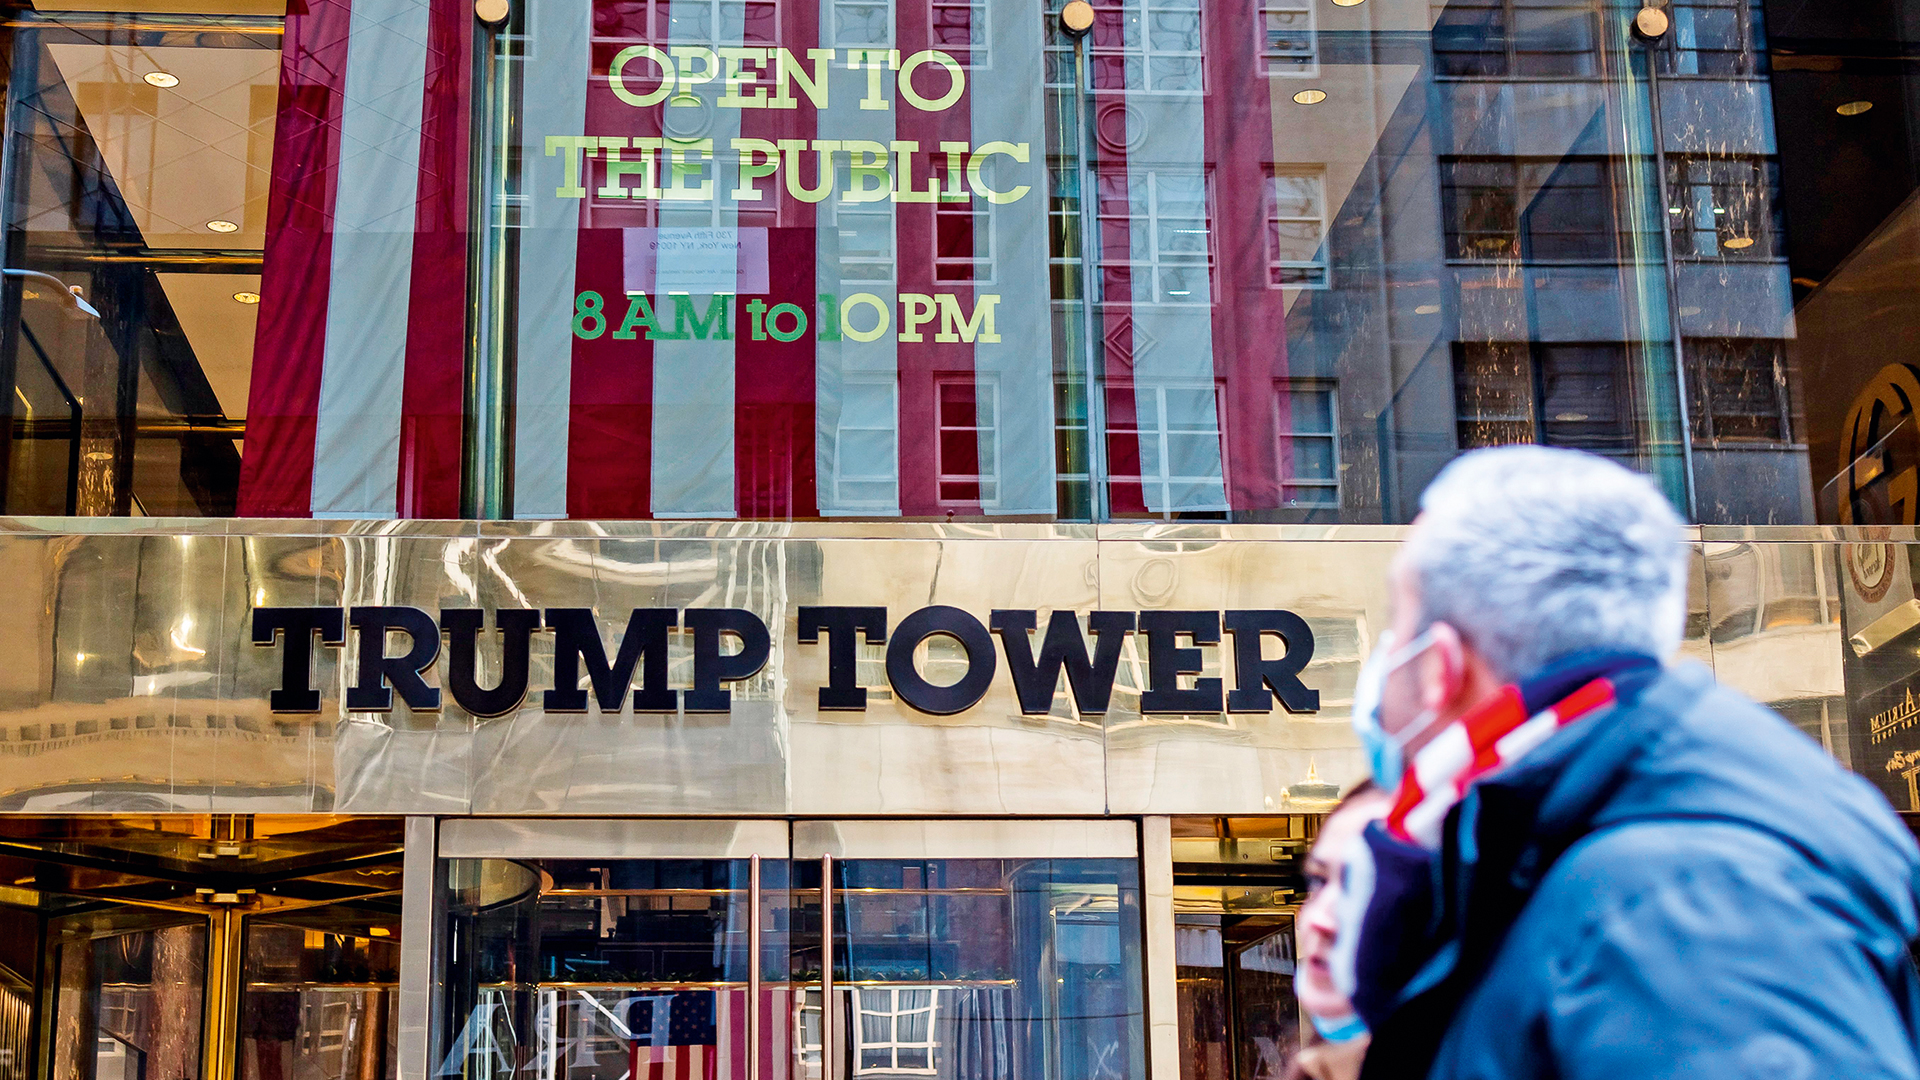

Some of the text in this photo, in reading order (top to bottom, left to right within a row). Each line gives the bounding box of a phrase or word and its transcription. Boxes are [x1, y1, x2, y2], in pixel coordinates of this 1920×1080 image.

[608, 45, 966, 111] OPEN TO
[545, 135, 1032, 204] THE PUBLIC
[571, 291, 1002, 344] 8 AM to 10 PM
[252, 604, 1321, 717] TRUMP TOWER
